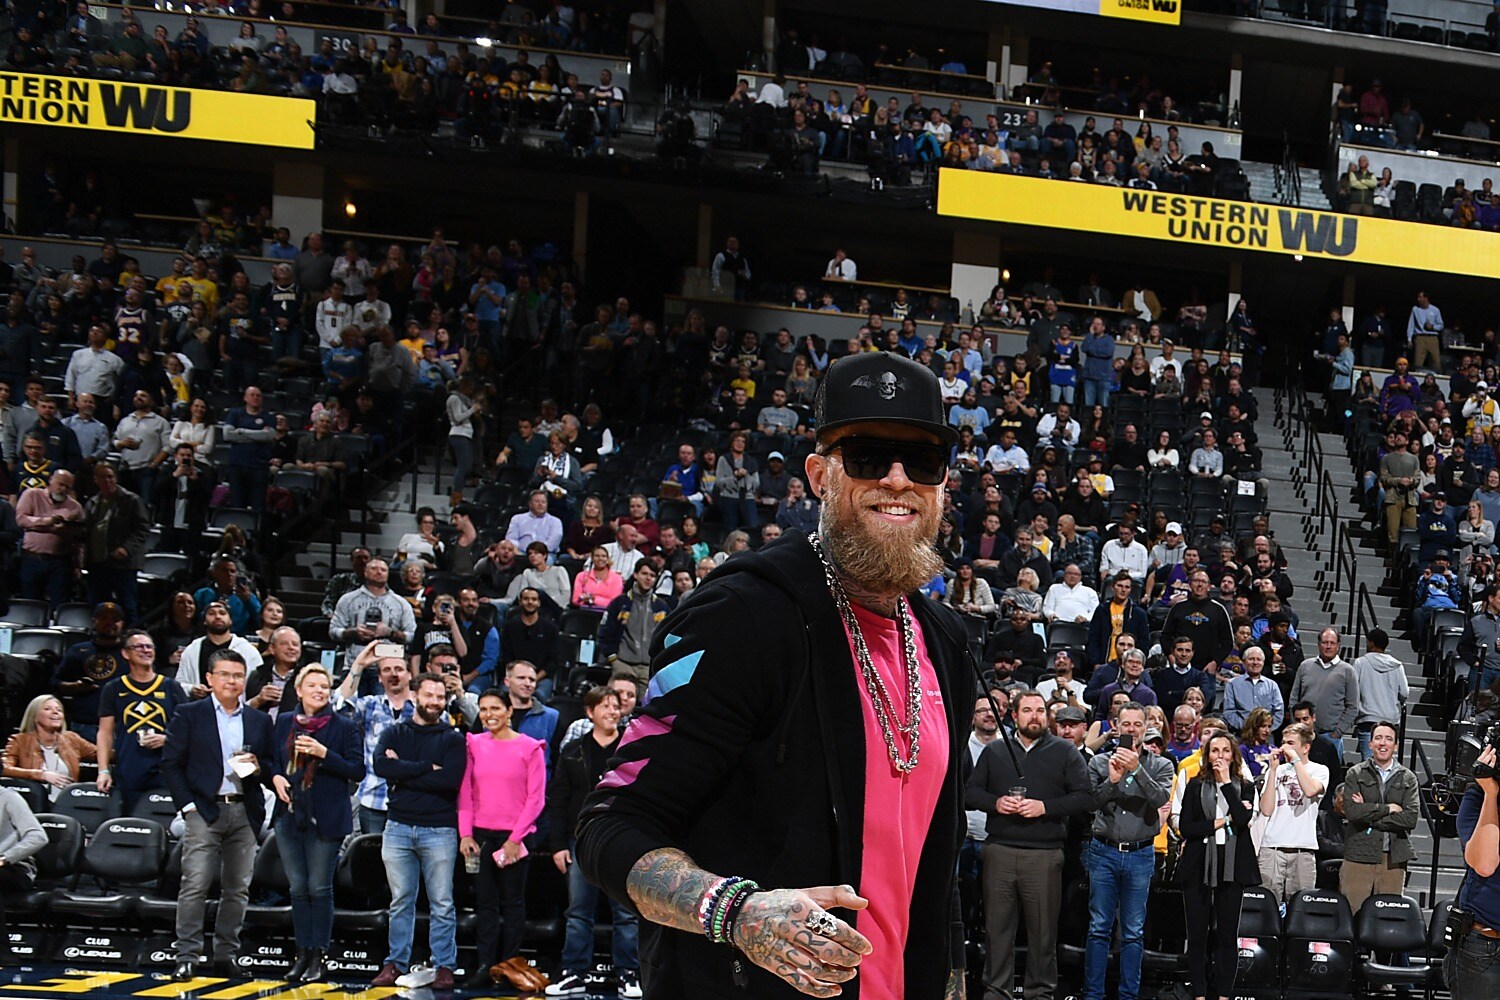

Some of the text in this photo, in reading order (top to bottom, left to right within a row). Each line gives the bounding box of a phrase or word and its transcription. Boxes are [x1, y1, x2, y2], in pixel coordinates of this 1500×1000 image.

[322, 36, 351, 51] 30
[0, 76, 90, 103] TERN
[0, 97, 90, 125] NION
[99, 83, 191, 132] WU
[1003, 112, 1027, 127] 23
[1123, 191, 1270, 227] WESTERN
[1168, 218, 1269, 248] UNION
[1278, 209, 1358, 256] WU
[118, 327, 142, 344] 32
[120, 826, 151, 834] LEXUS
[85, 937, 110, 945] CLUB
[80, 950, 122, 959] LEXUS
[258, 946, 283, 955] CLUB
[343, 950, 367, 959] CLUB
[339, 962, 379, 971] LEXUS
